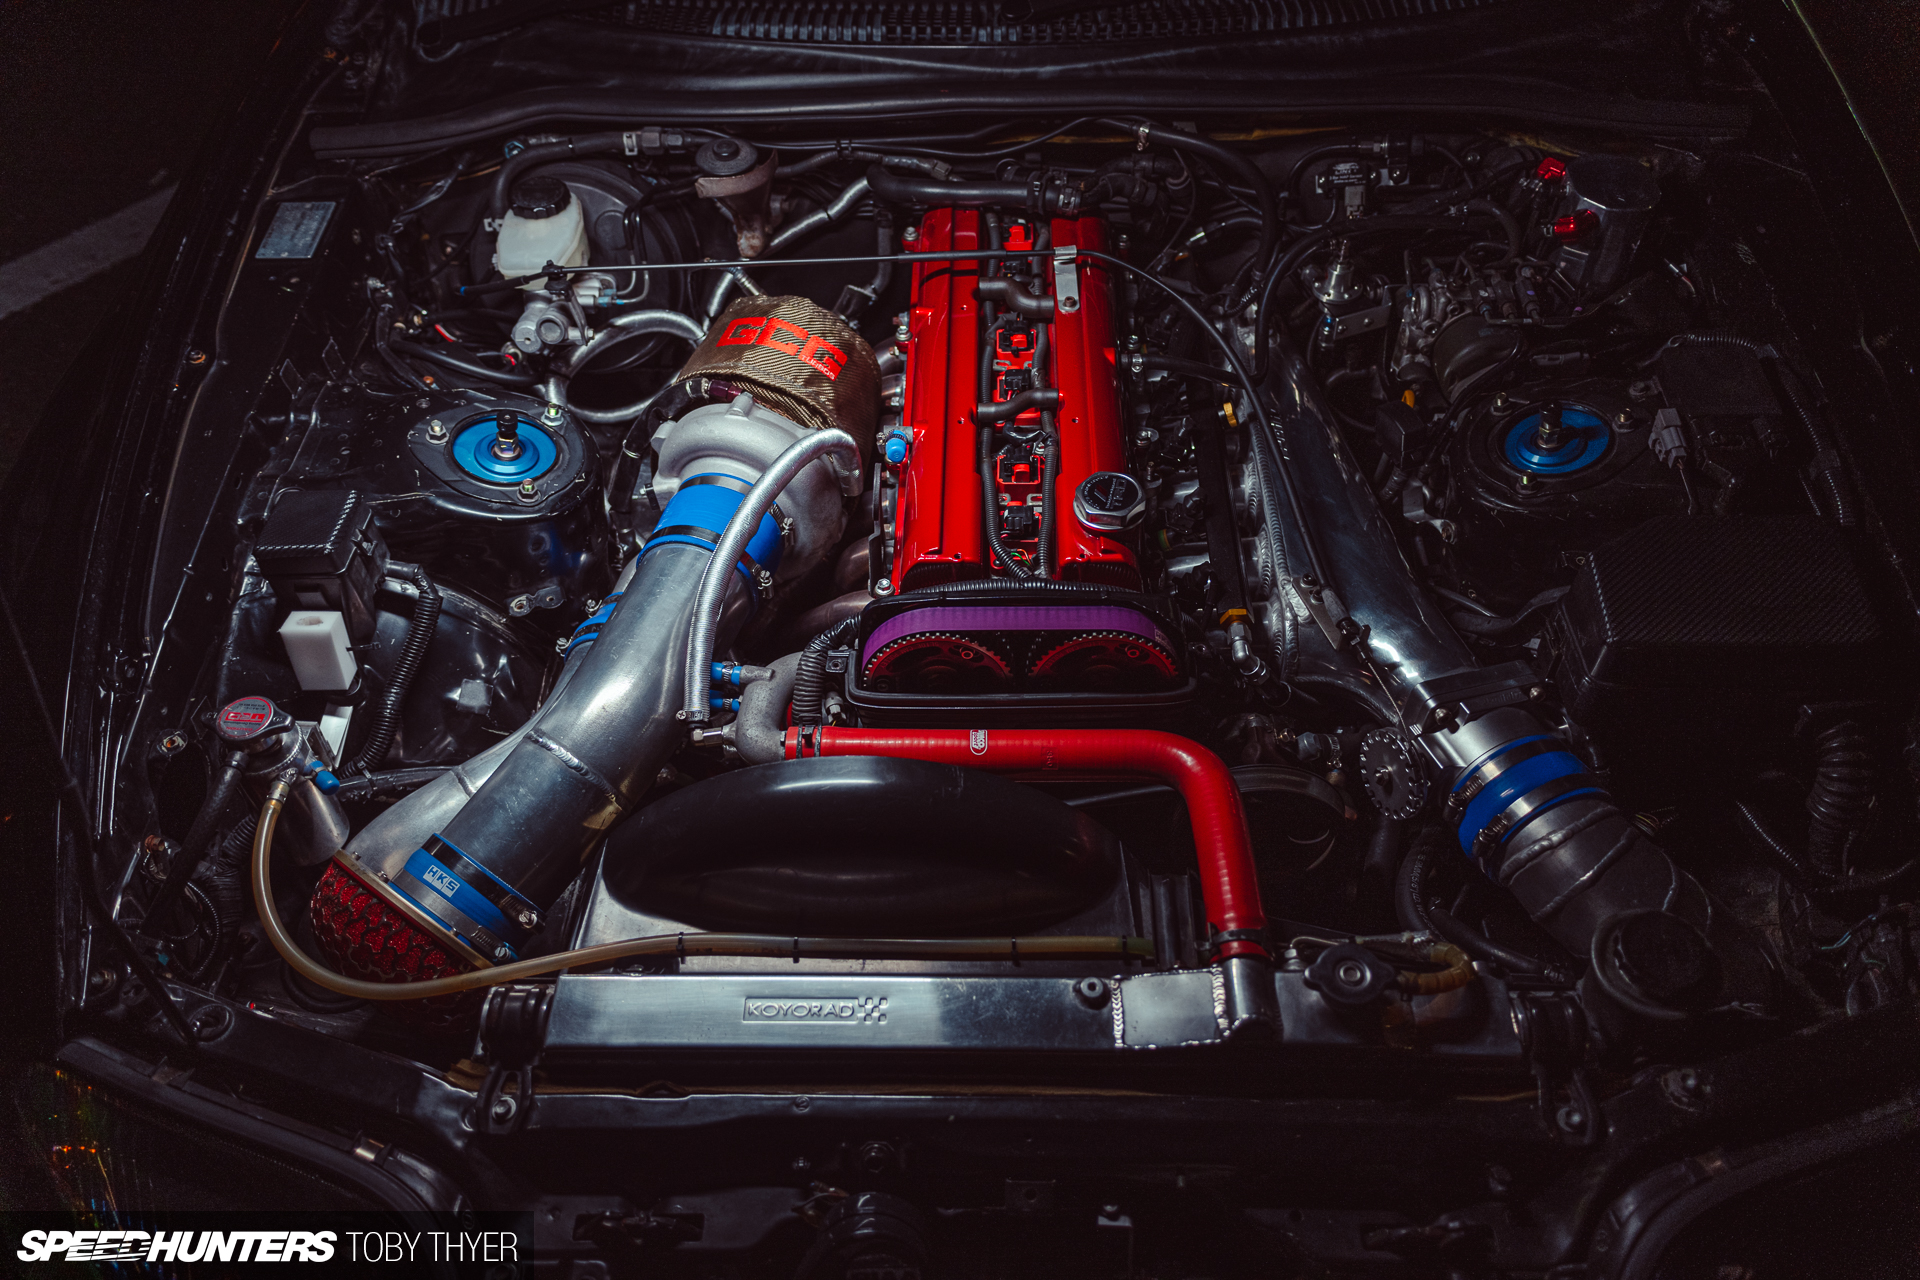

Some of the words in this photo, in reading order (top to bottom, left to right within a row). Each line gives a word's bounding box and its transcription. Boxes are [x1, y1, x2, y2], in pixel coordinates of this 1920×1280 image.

[716, 316, 848, 382] GCG
[801, 354, 836, 381] TURBOS
[427, 866, 460, 893] HKS
[748, 1002, 855, 1018] KOYORAD
